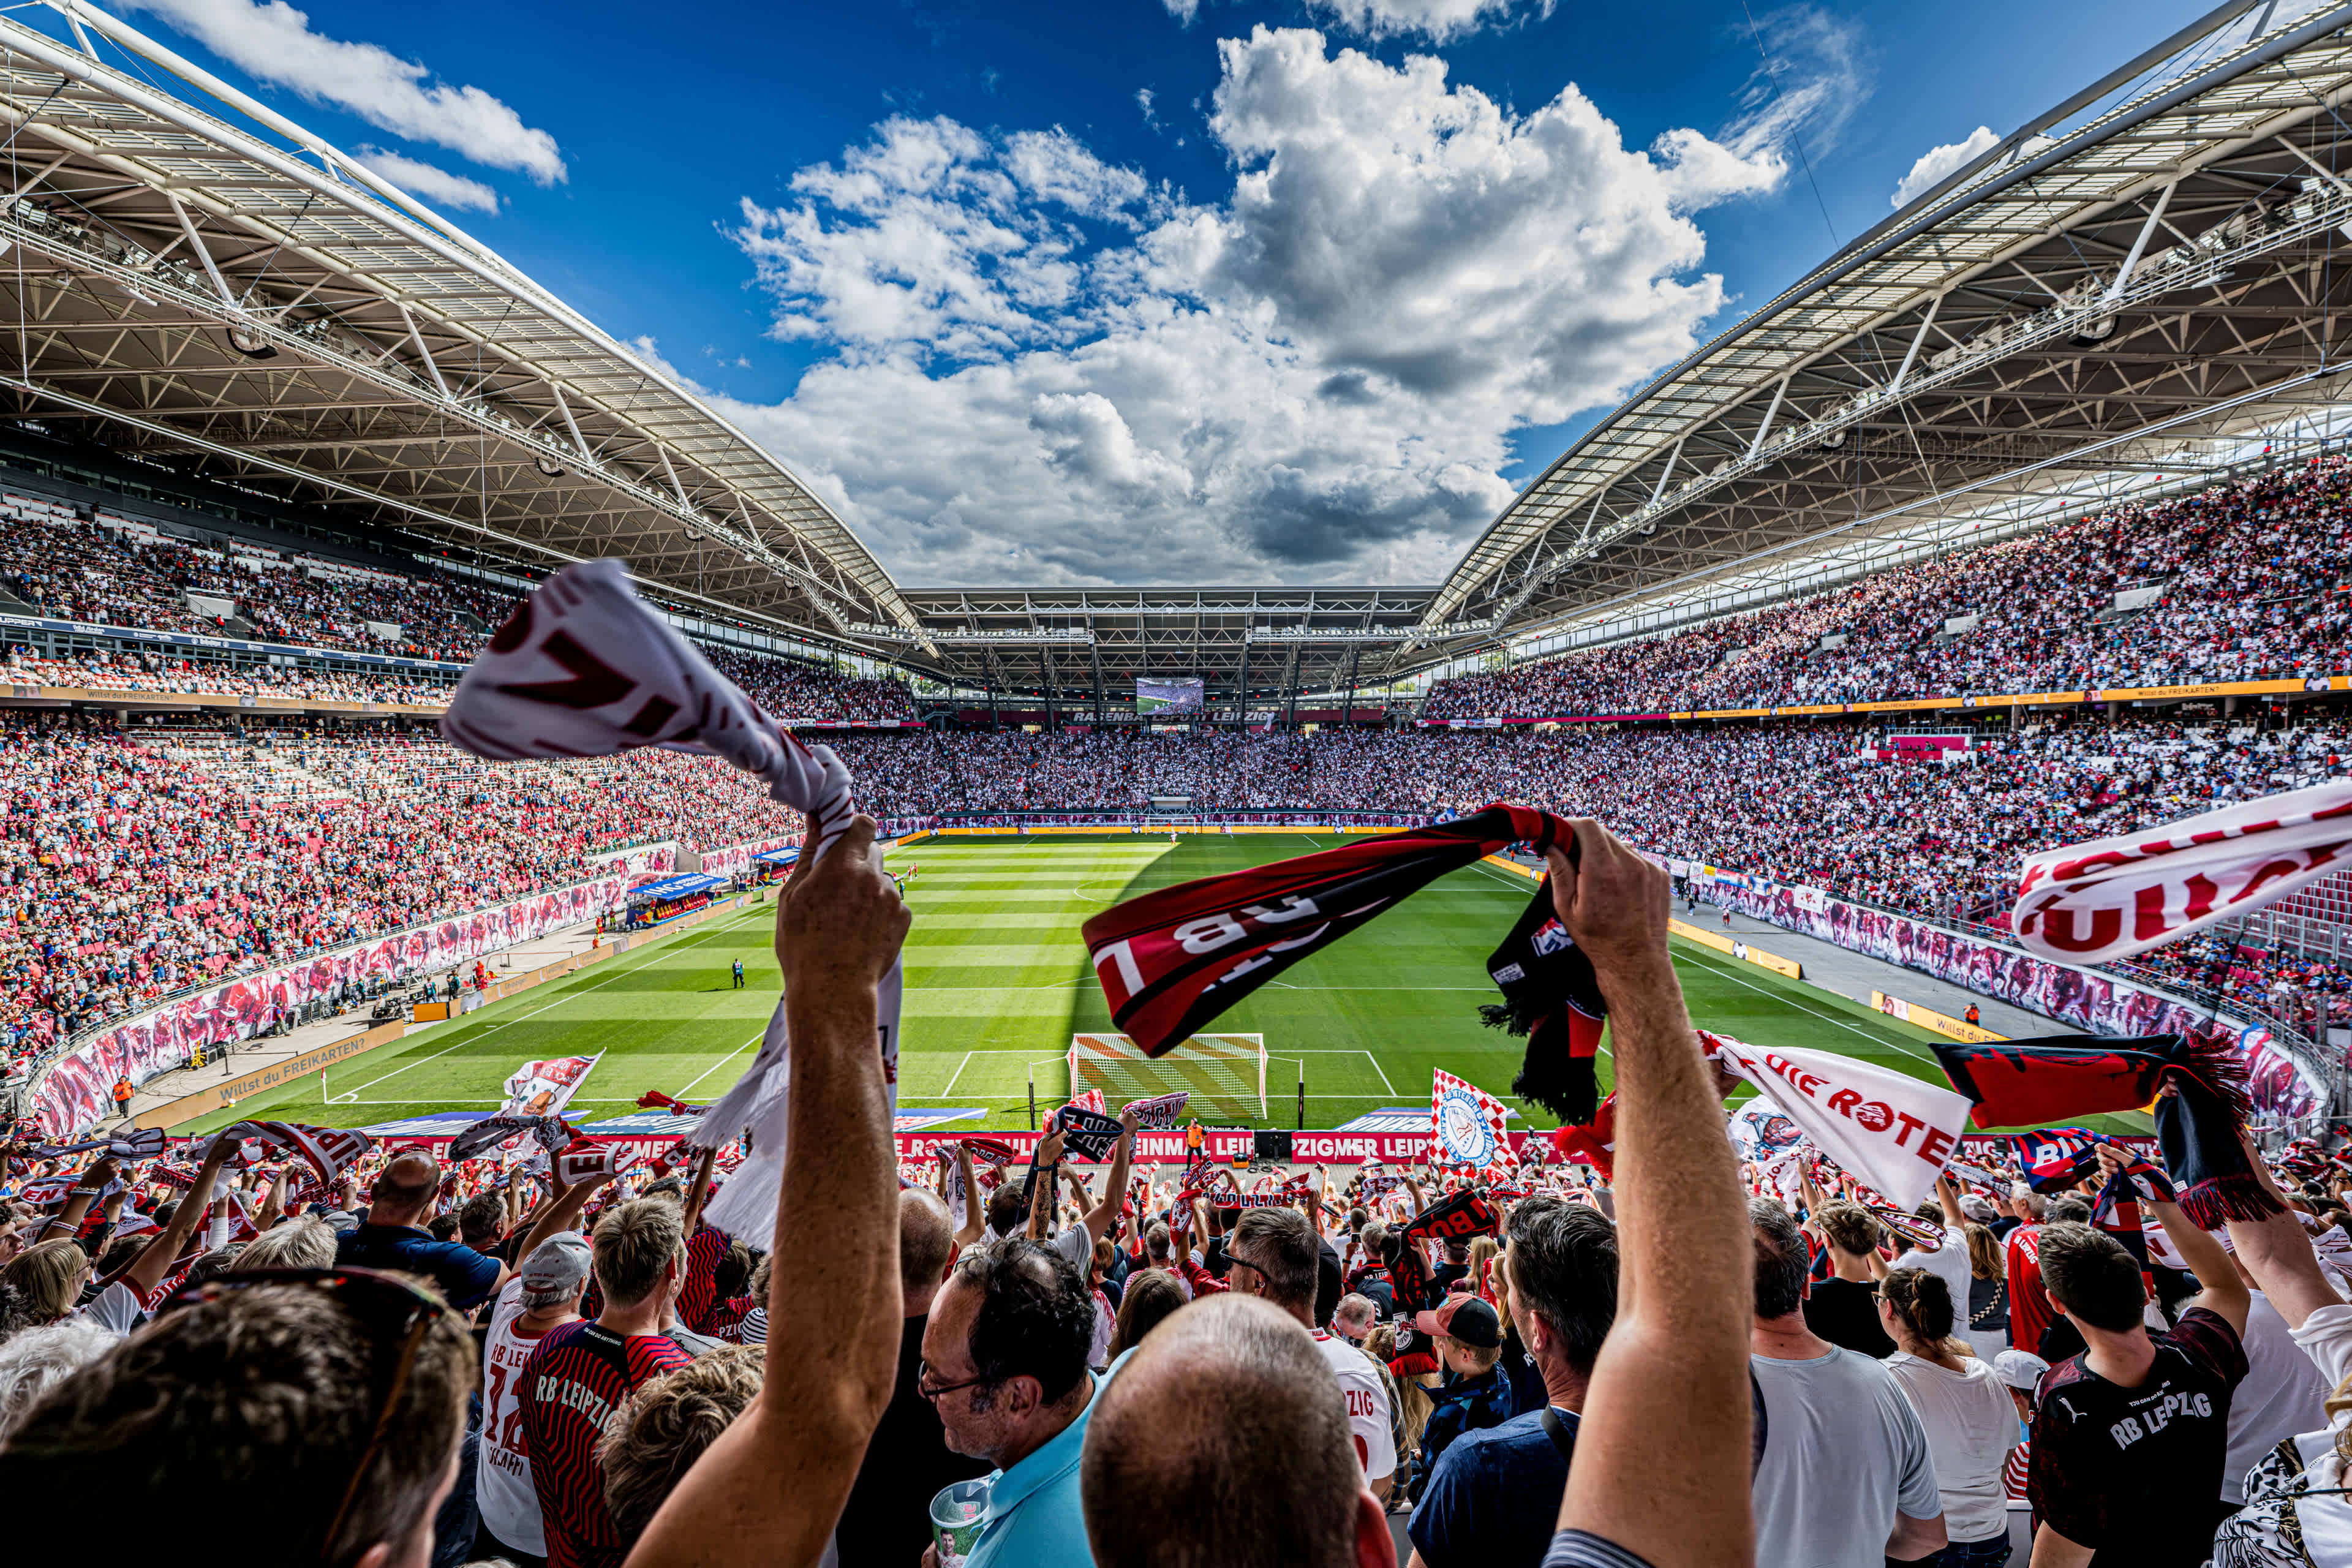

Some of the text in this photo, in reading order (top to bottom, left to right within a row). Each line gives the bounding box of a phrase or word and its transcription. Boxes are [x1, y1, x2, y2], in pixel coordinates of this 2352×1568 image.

[643, 883, 684, 895] IHG
[1937, 1018, 1965, 1038] Willst
[1968, 1028, 1983, 1040] du
[219, 1038, 365, 1101] Willst du FREIKARTEN?
[1828, 1088, 1956, 1169] ROTE
[1384, 1139, 1430, 1156] LEIP
[601, 1335, 622, 1346] ANYTHING
[491, 1343, 529, 1369] RB LEI
[535, 1375, 558, 1402] RB
[1344, 1390, 1373, 1416] ZIG
[2110, 1391, 2212, 1451] RB LEPZG
